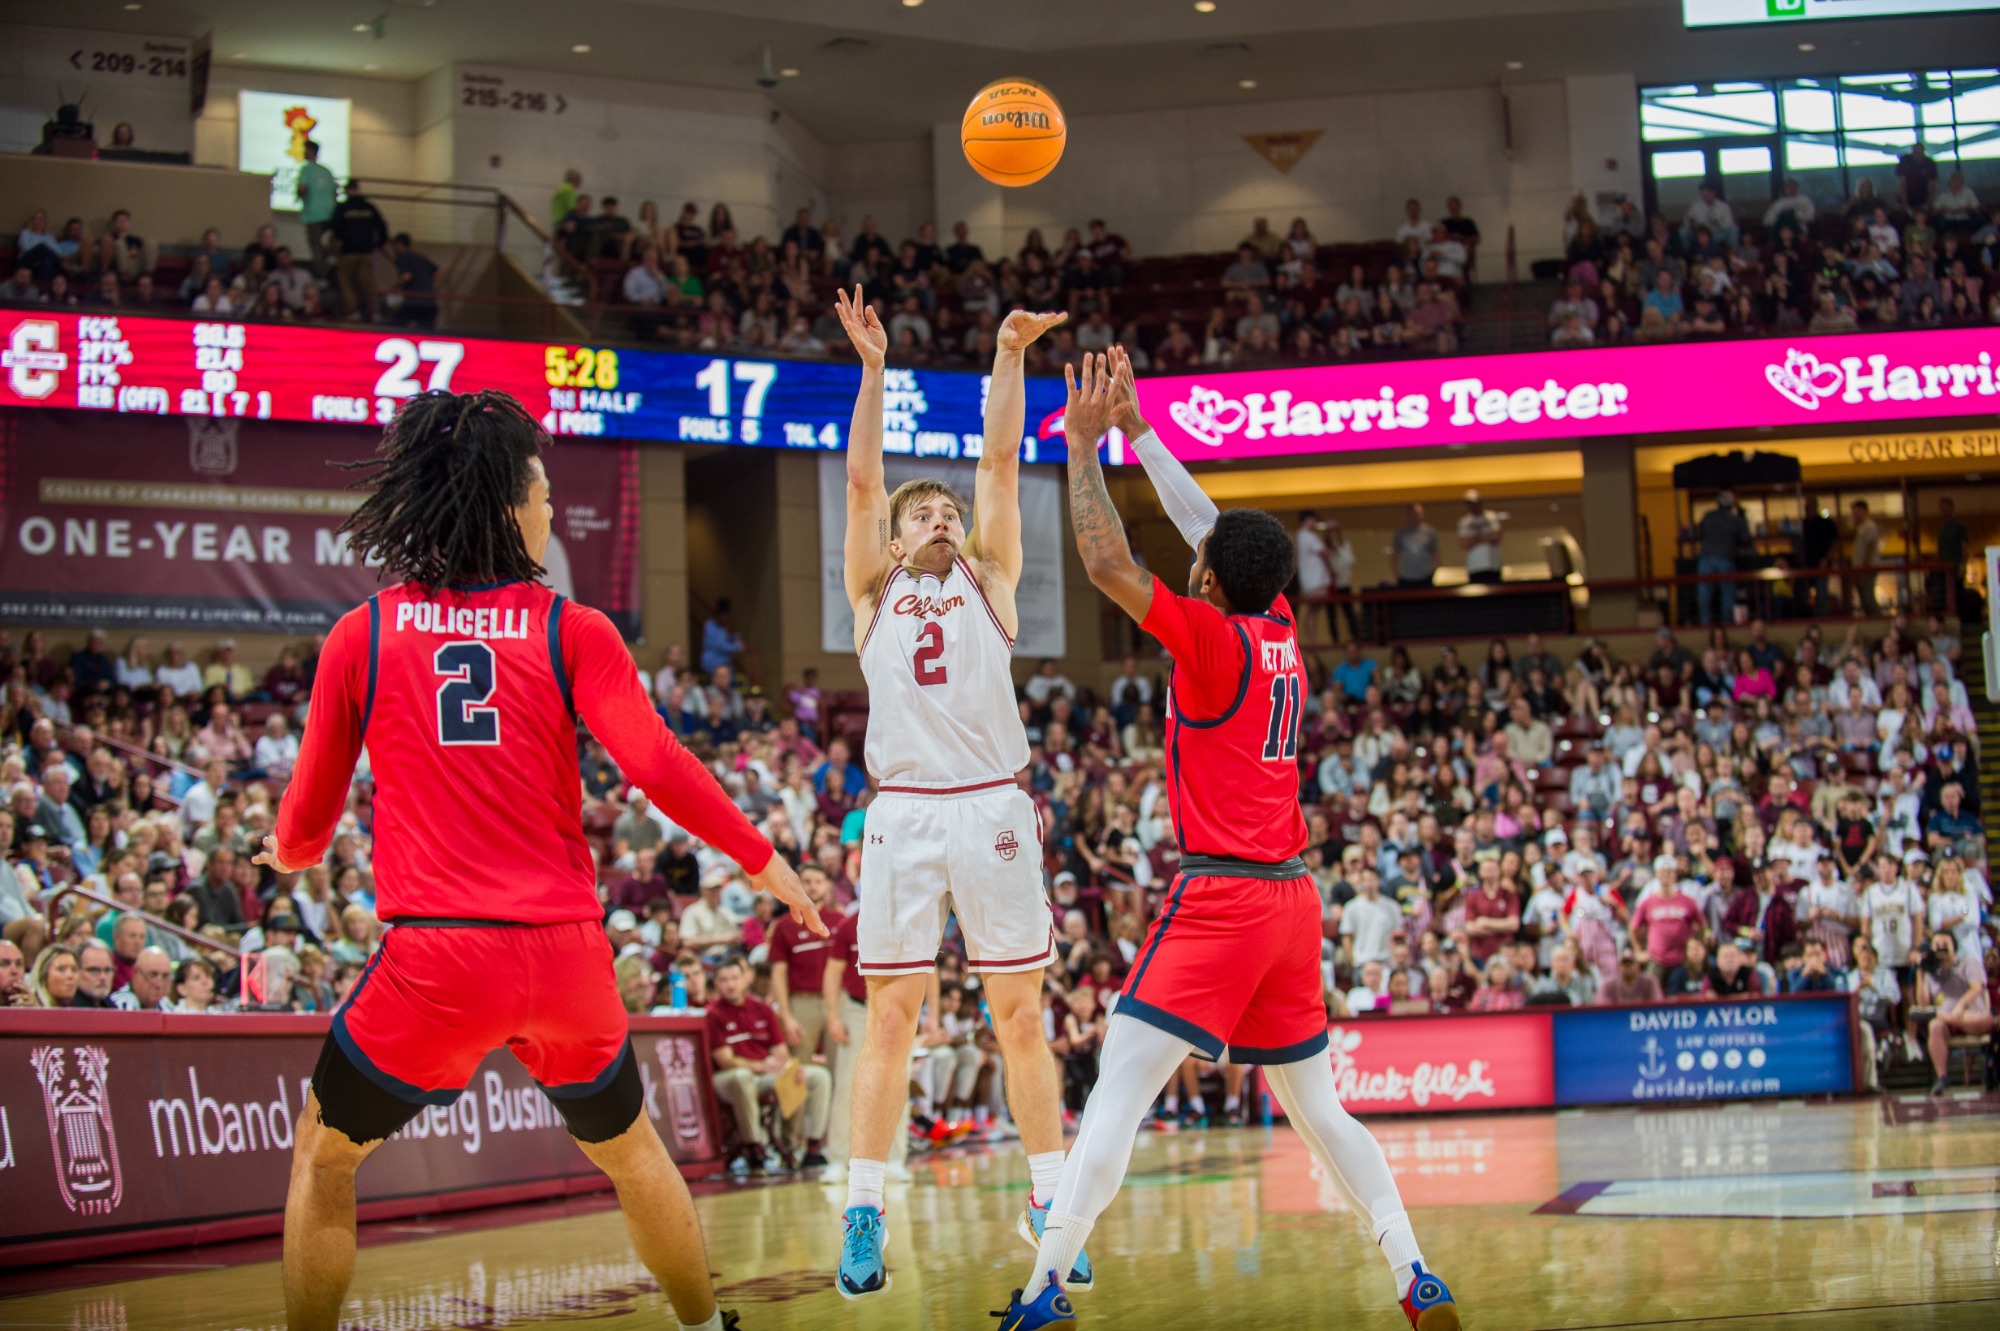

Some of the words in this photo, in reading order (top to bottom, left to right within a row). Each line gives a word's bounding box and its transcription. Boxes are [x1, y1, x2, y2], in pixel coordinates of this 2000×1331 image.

[982, 111, 1051, 130] Wilson
[374, 338, 464, 398] 27
[545, 346, 619, 390] 5:28
[1840, 351, 2000, 403] Harri
[579, 389, 643, 414] HALF
[696, 359, 778, 418] 17
[1244, 385, 1429, 439] Harris
[1441, 378, 1628, 427] Teeter
[312, 396, 368, 422] FOULS
[679, 416, 731, 441] FOULS
[740, 418, 761, 444] 5
[784, 421, 816, 447] TOL
[818, 423, 841, 448] 4
[1849, 437, 1955, 463] COUGAR
[18, 516, 292, 565] ONE-YEAR
[396, 602, 529, 639] POLICELLI
[913, 621, 948, 687] 2
[433, 640, 501, 747] 2
[1261, 673, 1301, 763] 11
[1629, 1010, 1698, 1032] DAVID
[1704, 1005, 1779, 1028] AYLOR
[1676, 1034, 1705, 1050] LAW
[1708, 1031, 1766, 1048] OFFICES
[1632, 1075, 1781, 1100] davidaylor.com
